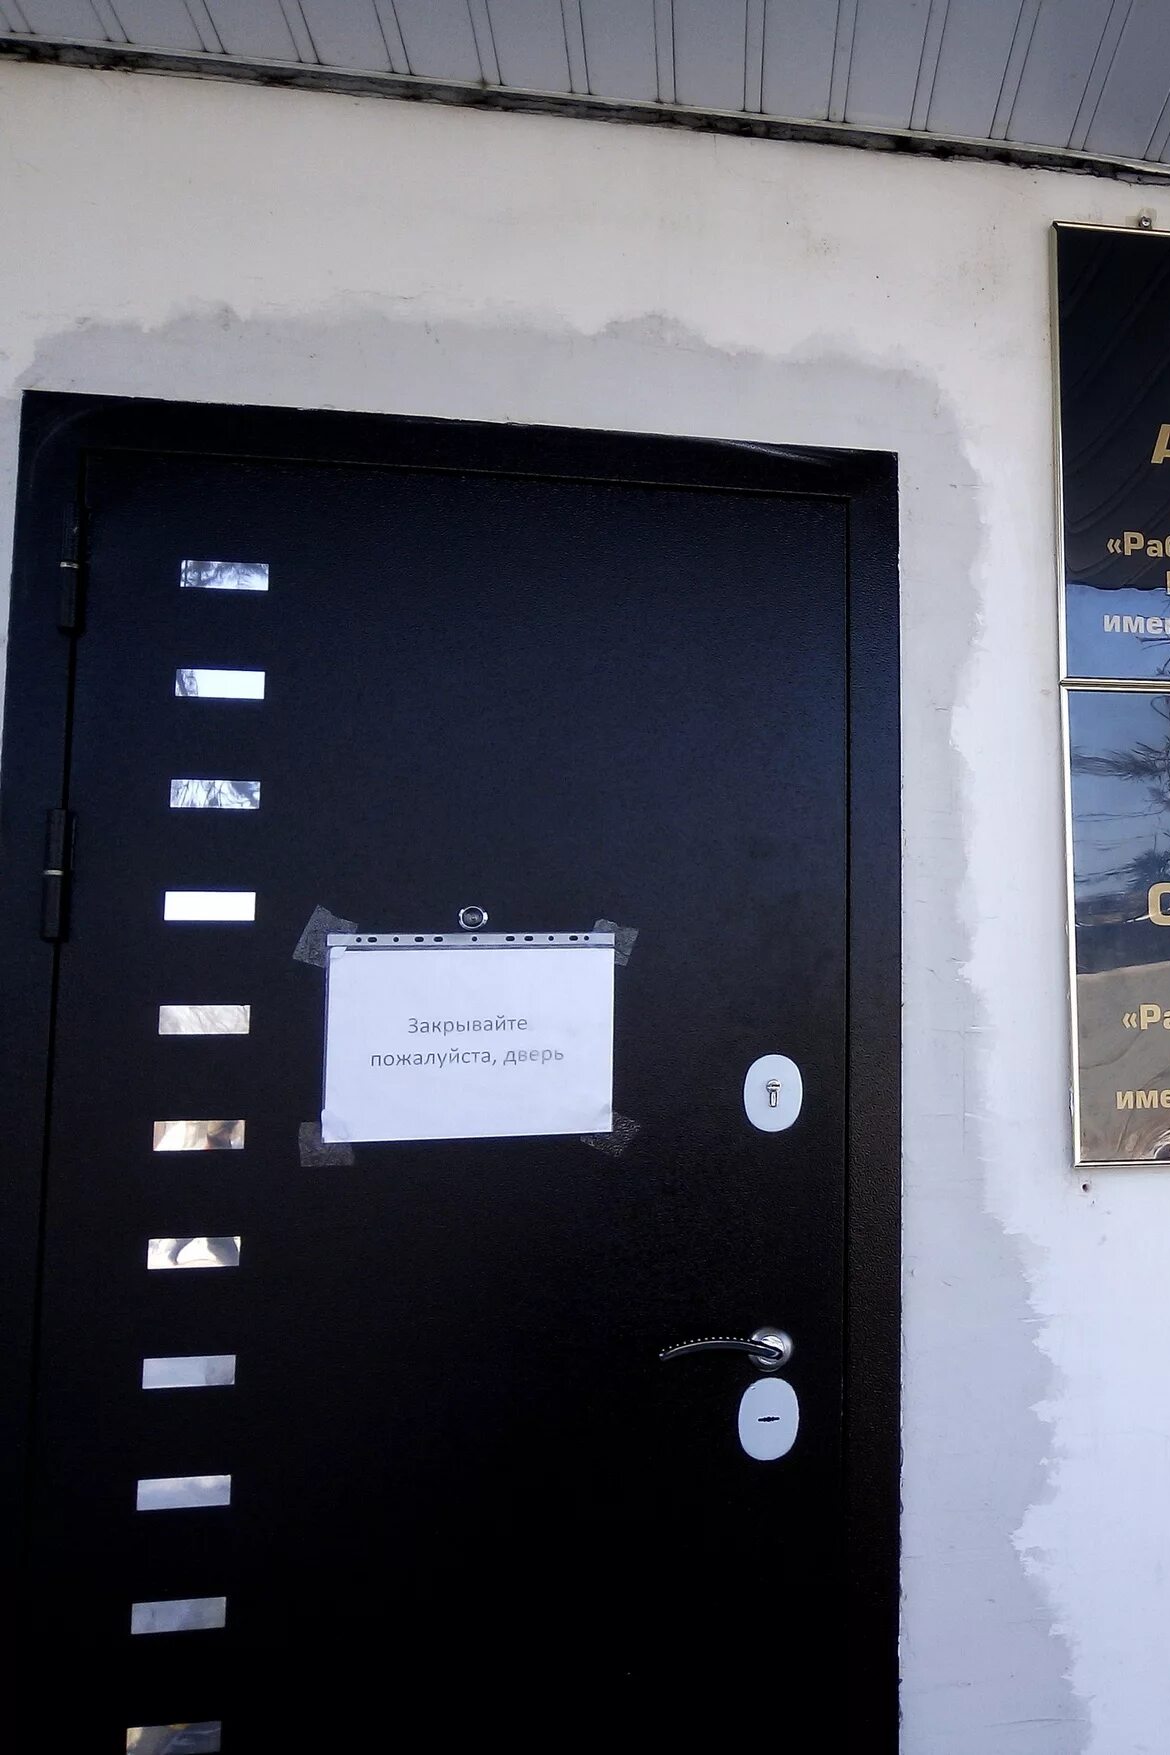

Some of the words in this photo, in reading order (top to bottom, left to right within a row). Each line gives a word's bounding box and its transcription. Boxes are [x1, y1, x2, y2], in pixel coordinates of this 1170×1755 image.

[408, 1015, 528, 1036] Закрывайте
[370, 1048, 497, 1068] пожалуйста,
[503, 1049, 564, 1065] дверь
